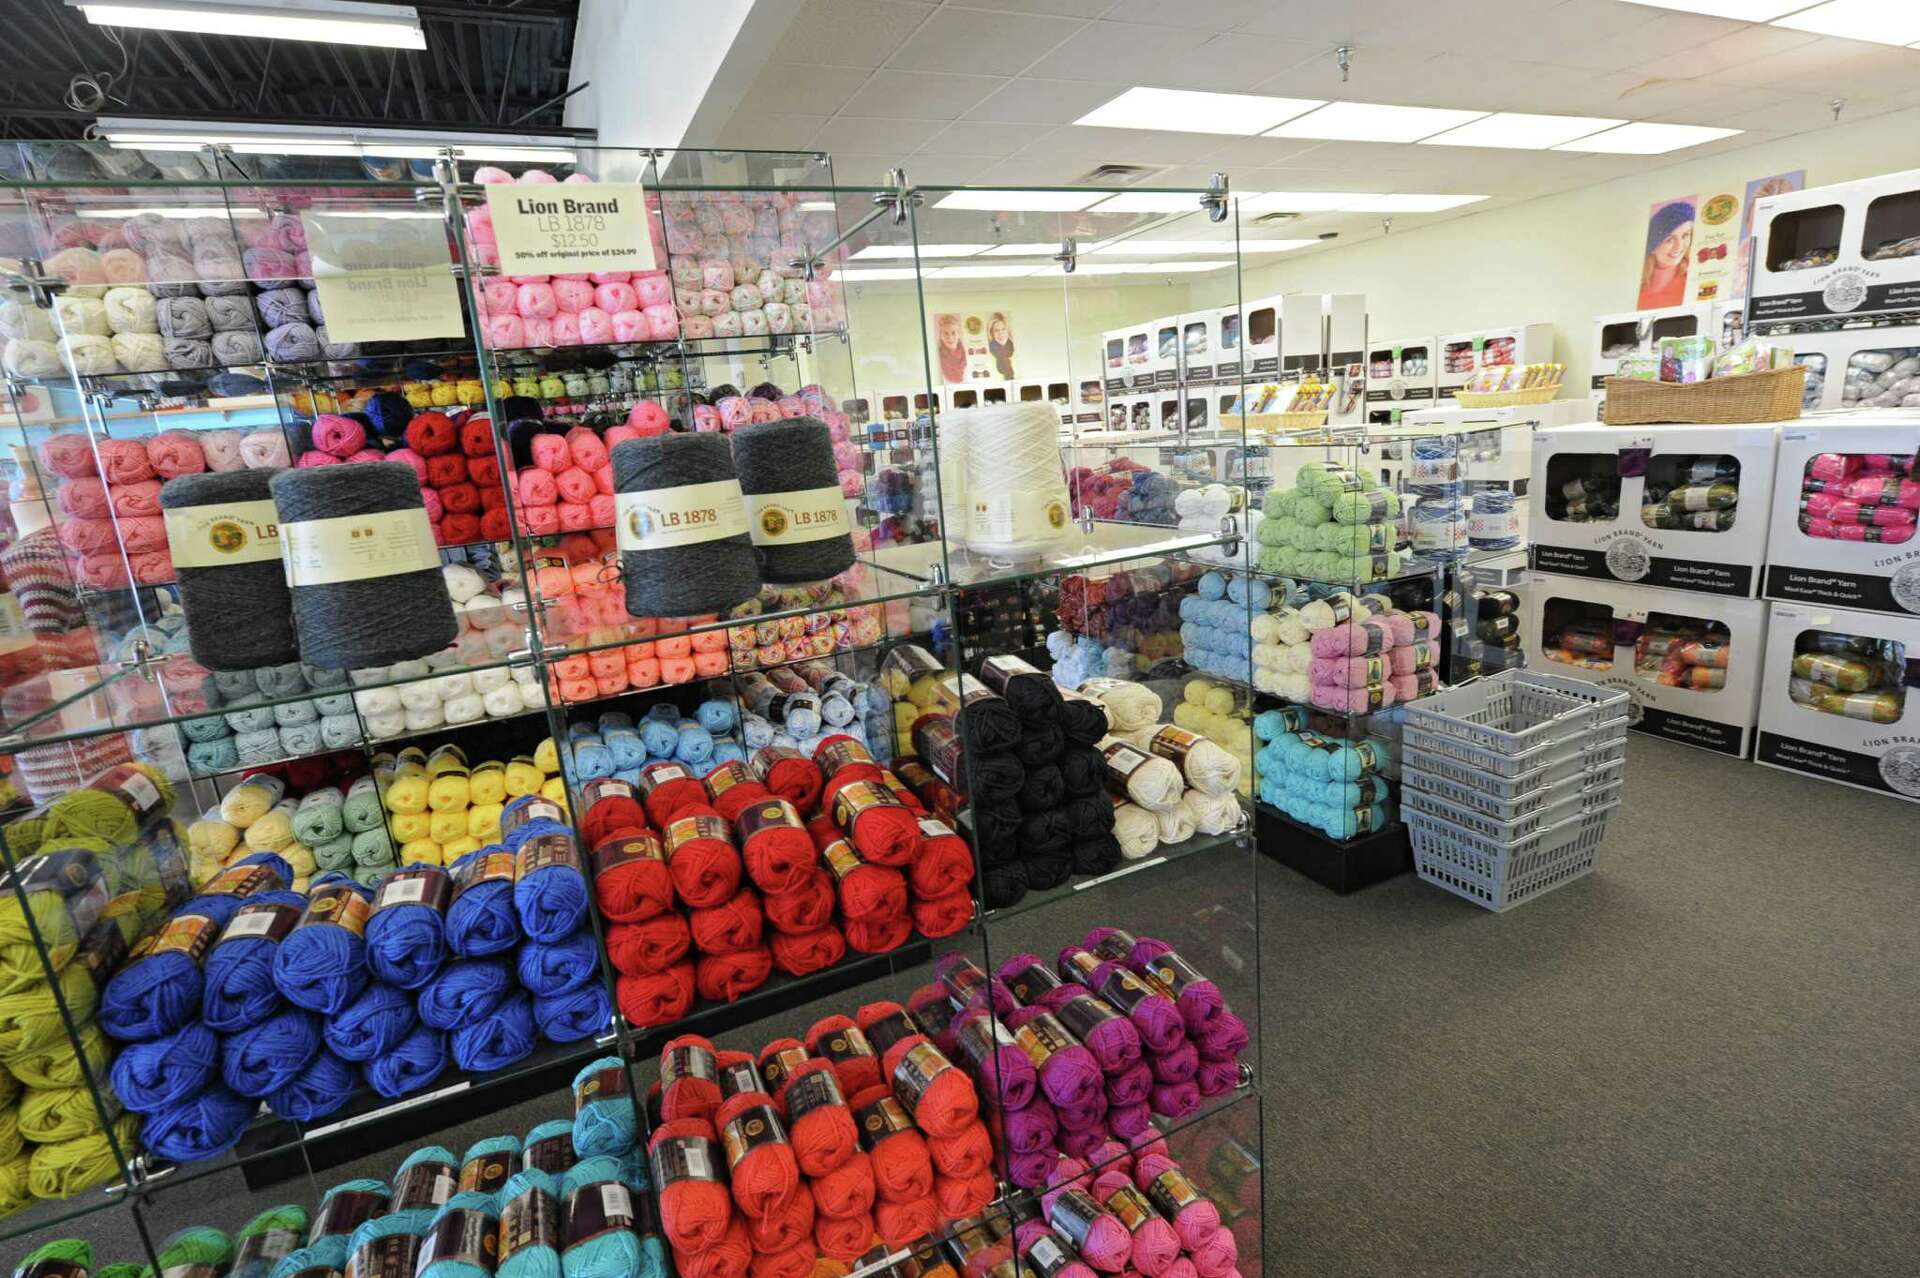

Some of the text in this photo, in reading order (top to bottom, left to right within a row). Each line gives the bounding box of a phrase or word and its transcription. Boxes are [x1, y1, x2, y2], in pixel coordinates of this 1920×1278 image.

[517, 198, 619, 214] Lion Brand
[538, 214, 606, 232] LB 1878
[536, 250, 548, 258] off
[549, 250, 579, 259] original
[581, 249, 600, 259] price
[661, 512, 680, 527] LB
[683, 508, 717, 524] 1878
[794, 509, 838, 525] LB 1878
[256, 524, 279, 540] LB
[1789, 574, 1807, 582] Lion
